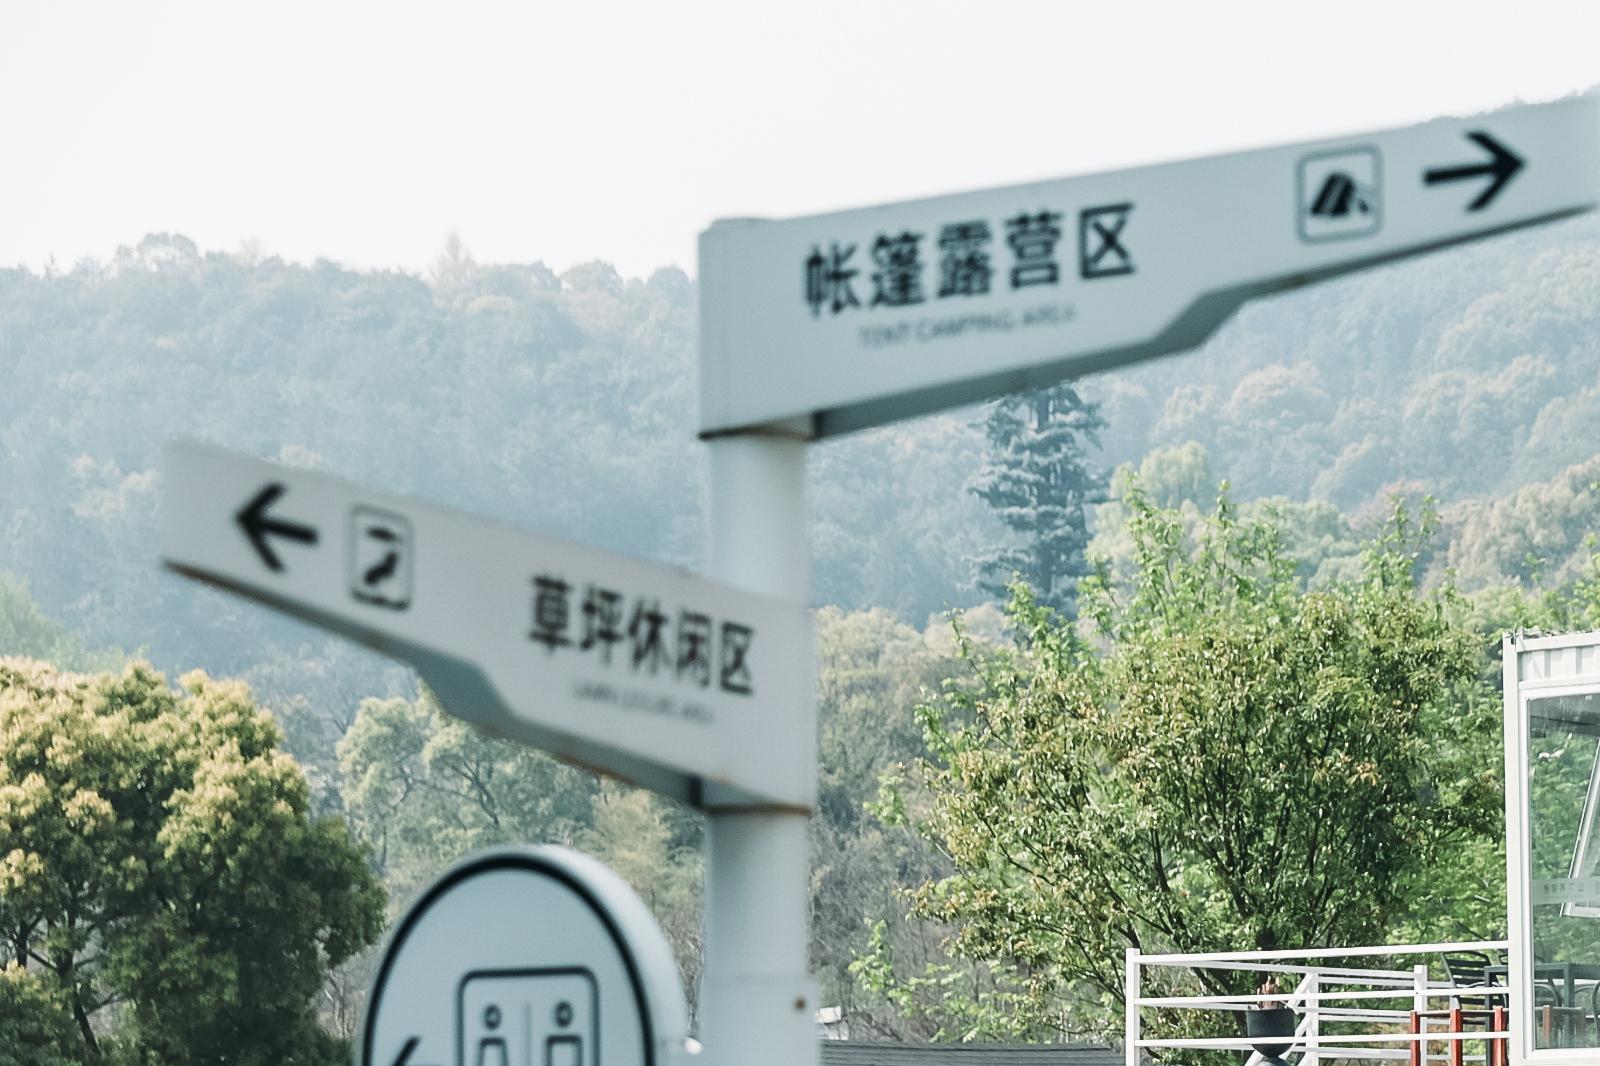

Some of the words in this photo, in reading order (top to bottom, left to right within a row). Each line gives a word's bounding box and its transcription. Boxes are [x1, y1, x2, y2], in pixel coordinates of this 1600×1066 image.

[804, 203, 1136, 318] 帐篷露营区
[528, 574, 755, 695] 草坪休闲区
